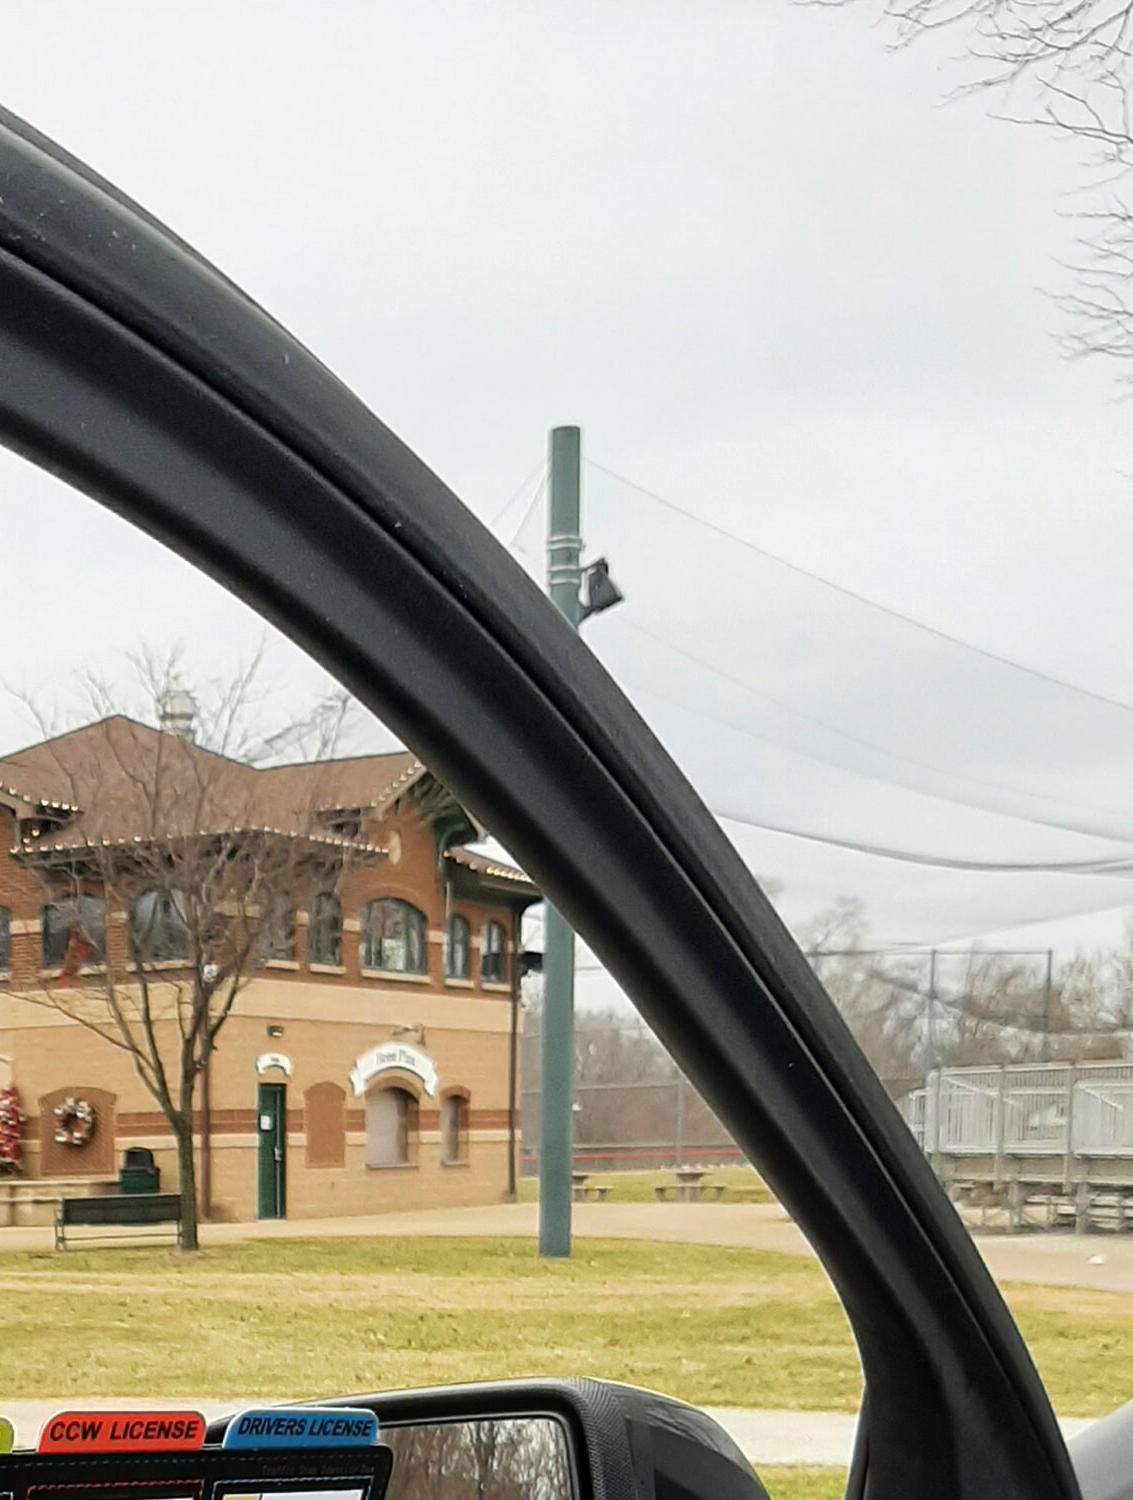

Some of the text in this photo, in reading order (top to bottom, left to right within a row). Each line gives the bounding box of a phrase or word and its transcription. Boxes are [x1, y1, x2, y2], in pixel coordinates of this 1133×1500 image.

[49, 1420, 200, 1441] CCW LICENSE
[237, 1417, 374, 1437] DRIVERS LICENSE
